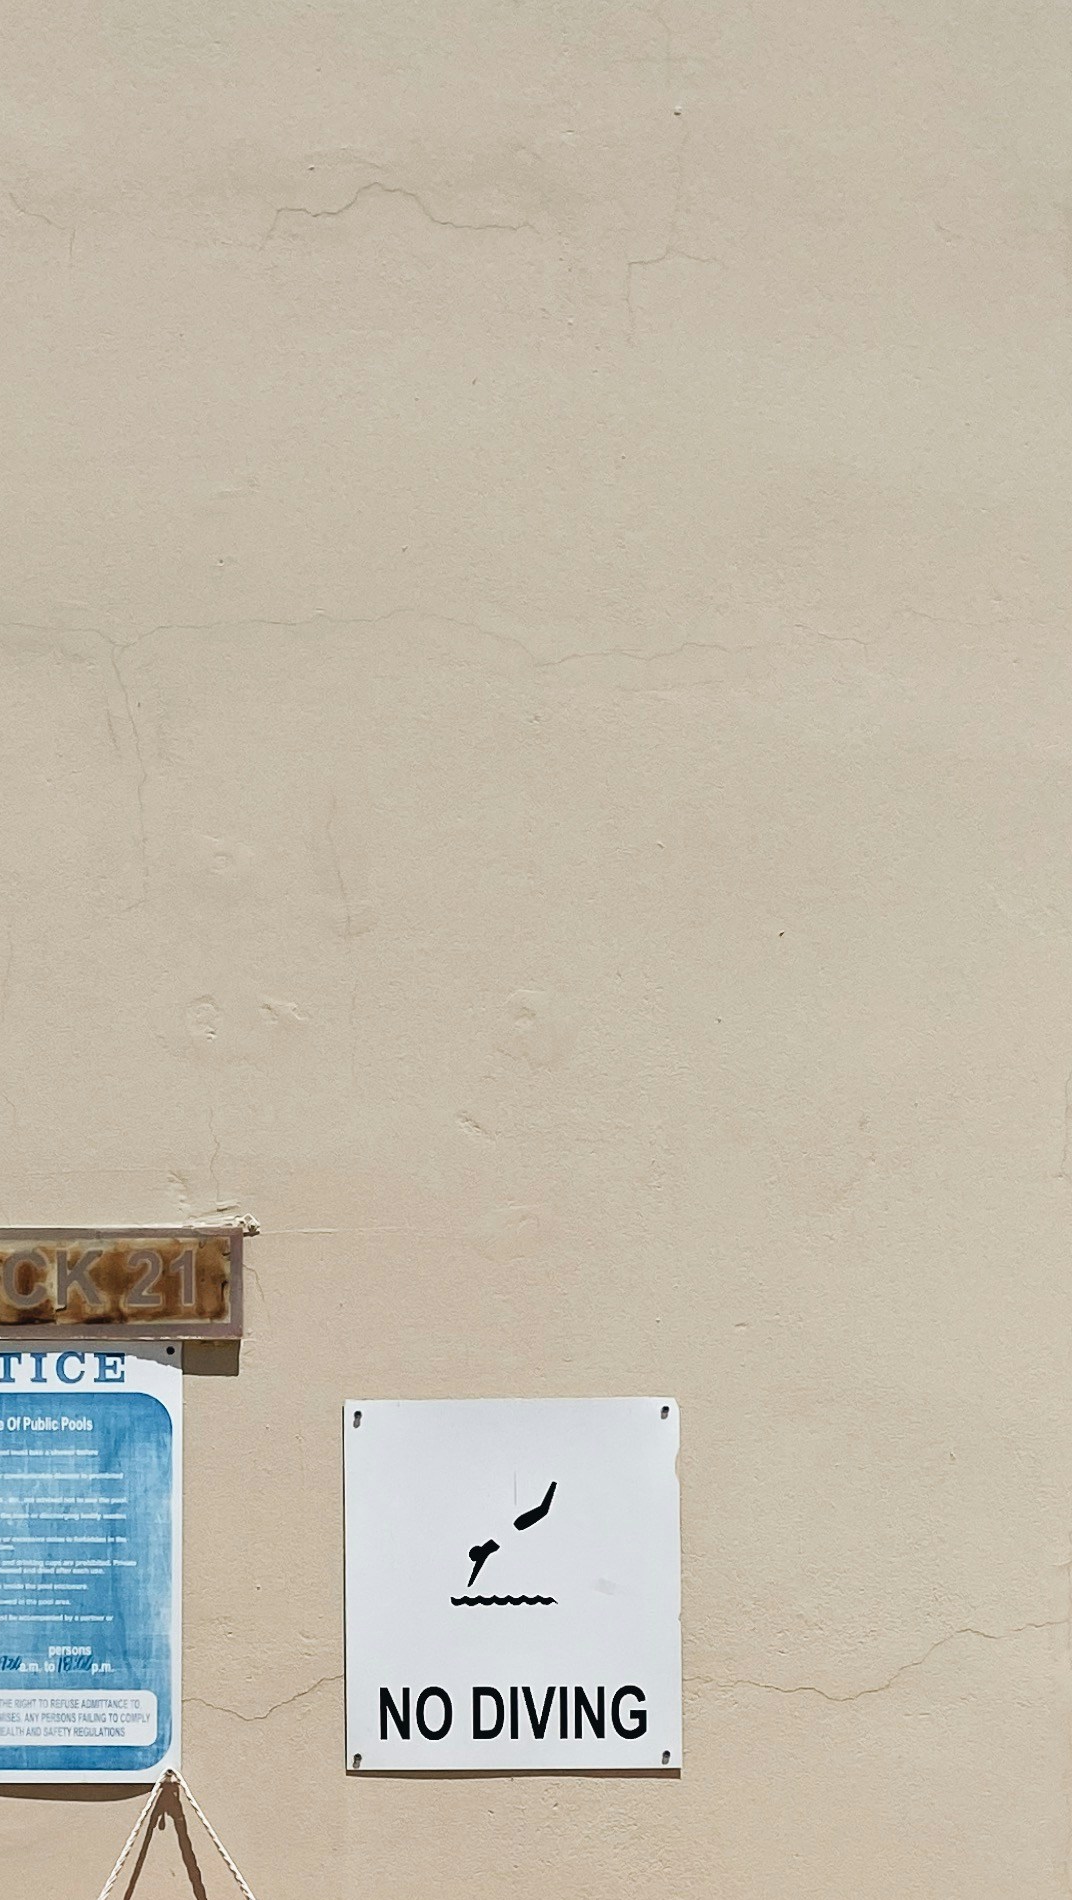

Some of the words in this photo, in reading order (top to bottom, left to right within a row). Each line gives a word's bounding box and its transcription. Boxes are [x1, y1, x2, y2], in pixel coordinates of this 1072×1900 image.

[125, 1248, 197, 1308] 21
[6, 1417, 21, 1431] Of
[22, 1417, 59, 1431] Public
[60, 1416, 94, 1431] Pools
[48, 1645, 92, 1658] persons
[43, 1660, 56, 1672] to
[91, 1662, 115, 1675] p.m.
[14, 1698, 36, 1709] RIGHT
[38, 1698, 49, 1709] TO
[50, 1698, 79, 1709] REFUSE
[81, 1698, 128, 1709] ADMITTANCE
[24, 1712, 40, 1723] ANY
[41, 1712, 76, 1723] PERSONS
[78, 1712, 106, 1723] FAILING
[108, 1712, 118, 1723] TO
[119, 1712, 151, 1723] COMPLY
[379, 1685, 454, 1741] NO
[471, 1685, 648, 1740] DIVING
[25, 1726, 42, 1737] AND
[43, 1726, 71, 1737] SAFETY
[73, 1726, 126, 1737] REGULATIONS
